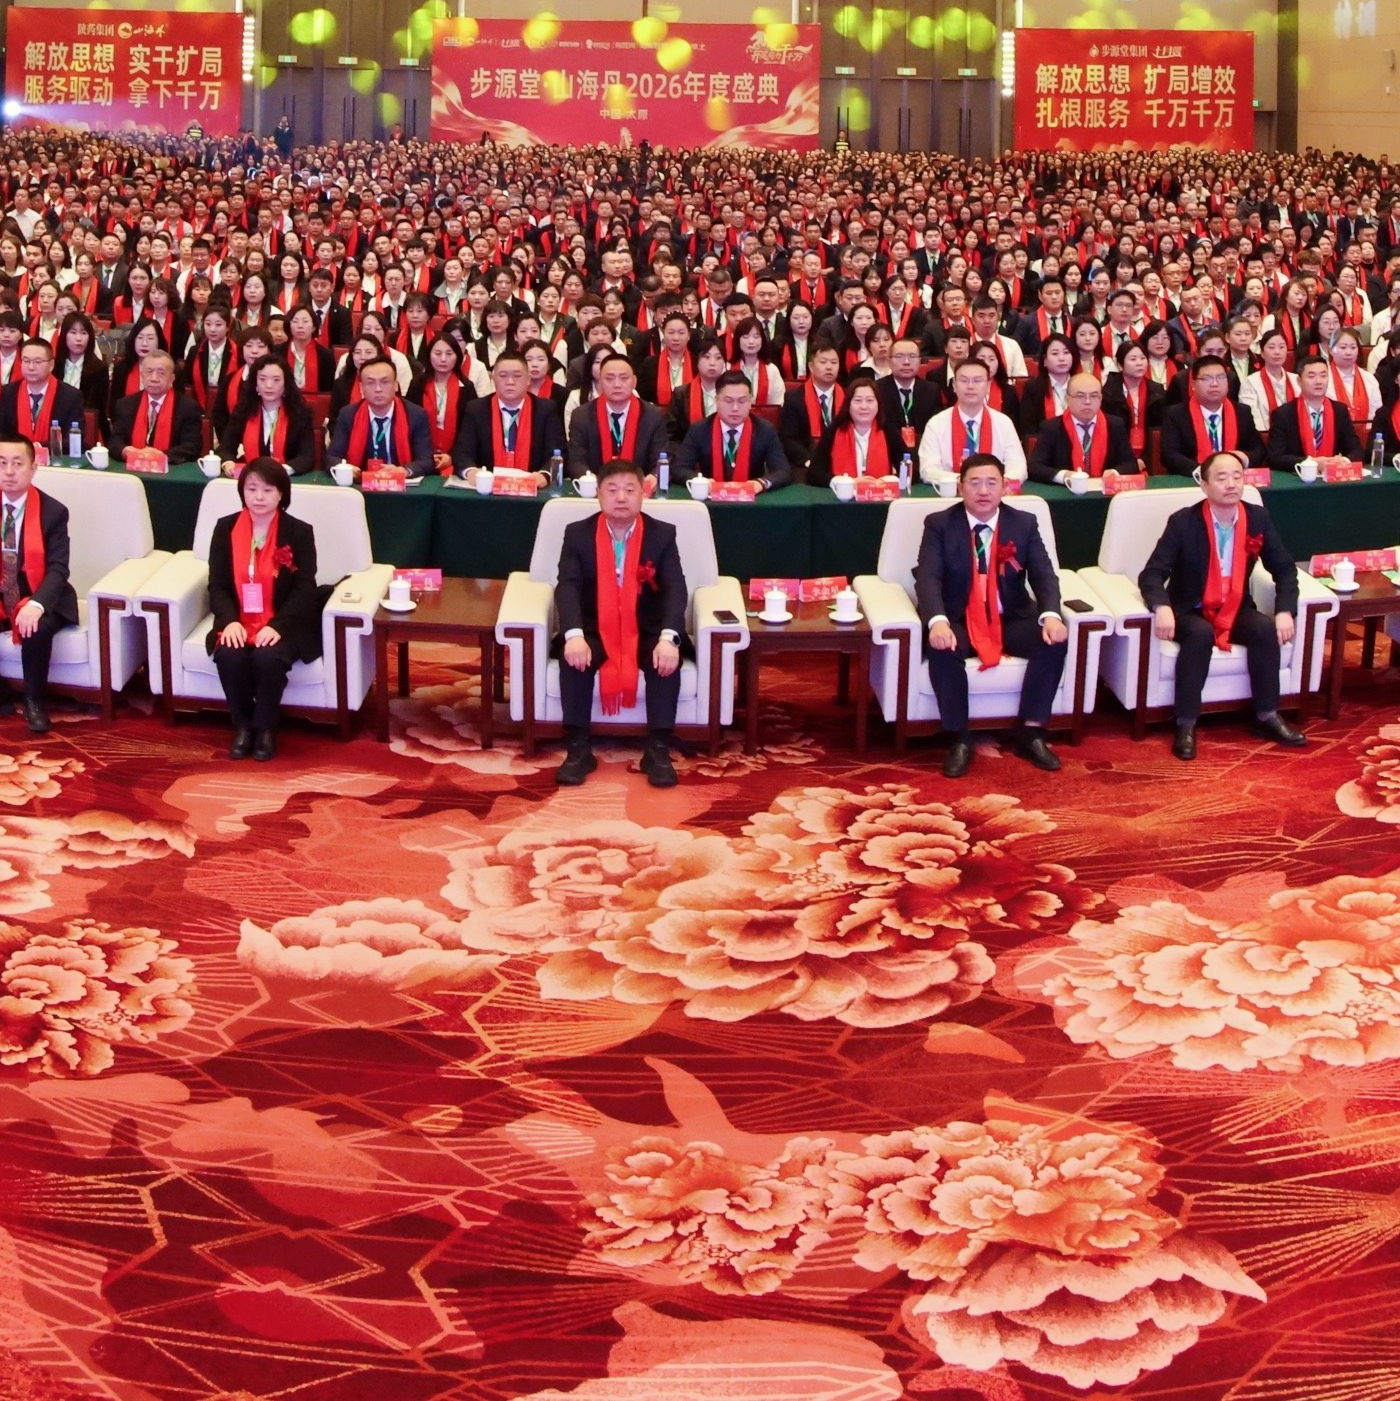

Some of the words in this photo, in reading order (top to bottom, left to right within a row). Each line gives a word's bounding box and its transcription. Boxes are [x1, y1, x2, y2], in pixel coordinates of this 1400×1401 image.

[24, 41, 115, 73] 解放思想
[129, 43, 222, 77] 实干扩局
[23, 74, 113, 107] 服务驱动
[128, 77, 222, 111] 拿下千万
[1035, 64, 1131, 96] 解放思想
[1144, 64, 1236, 96] 扩局增效
[1035, 98, 1131, 128] 扎根服务
[1144, 98, 1236, 128] 千万千万
